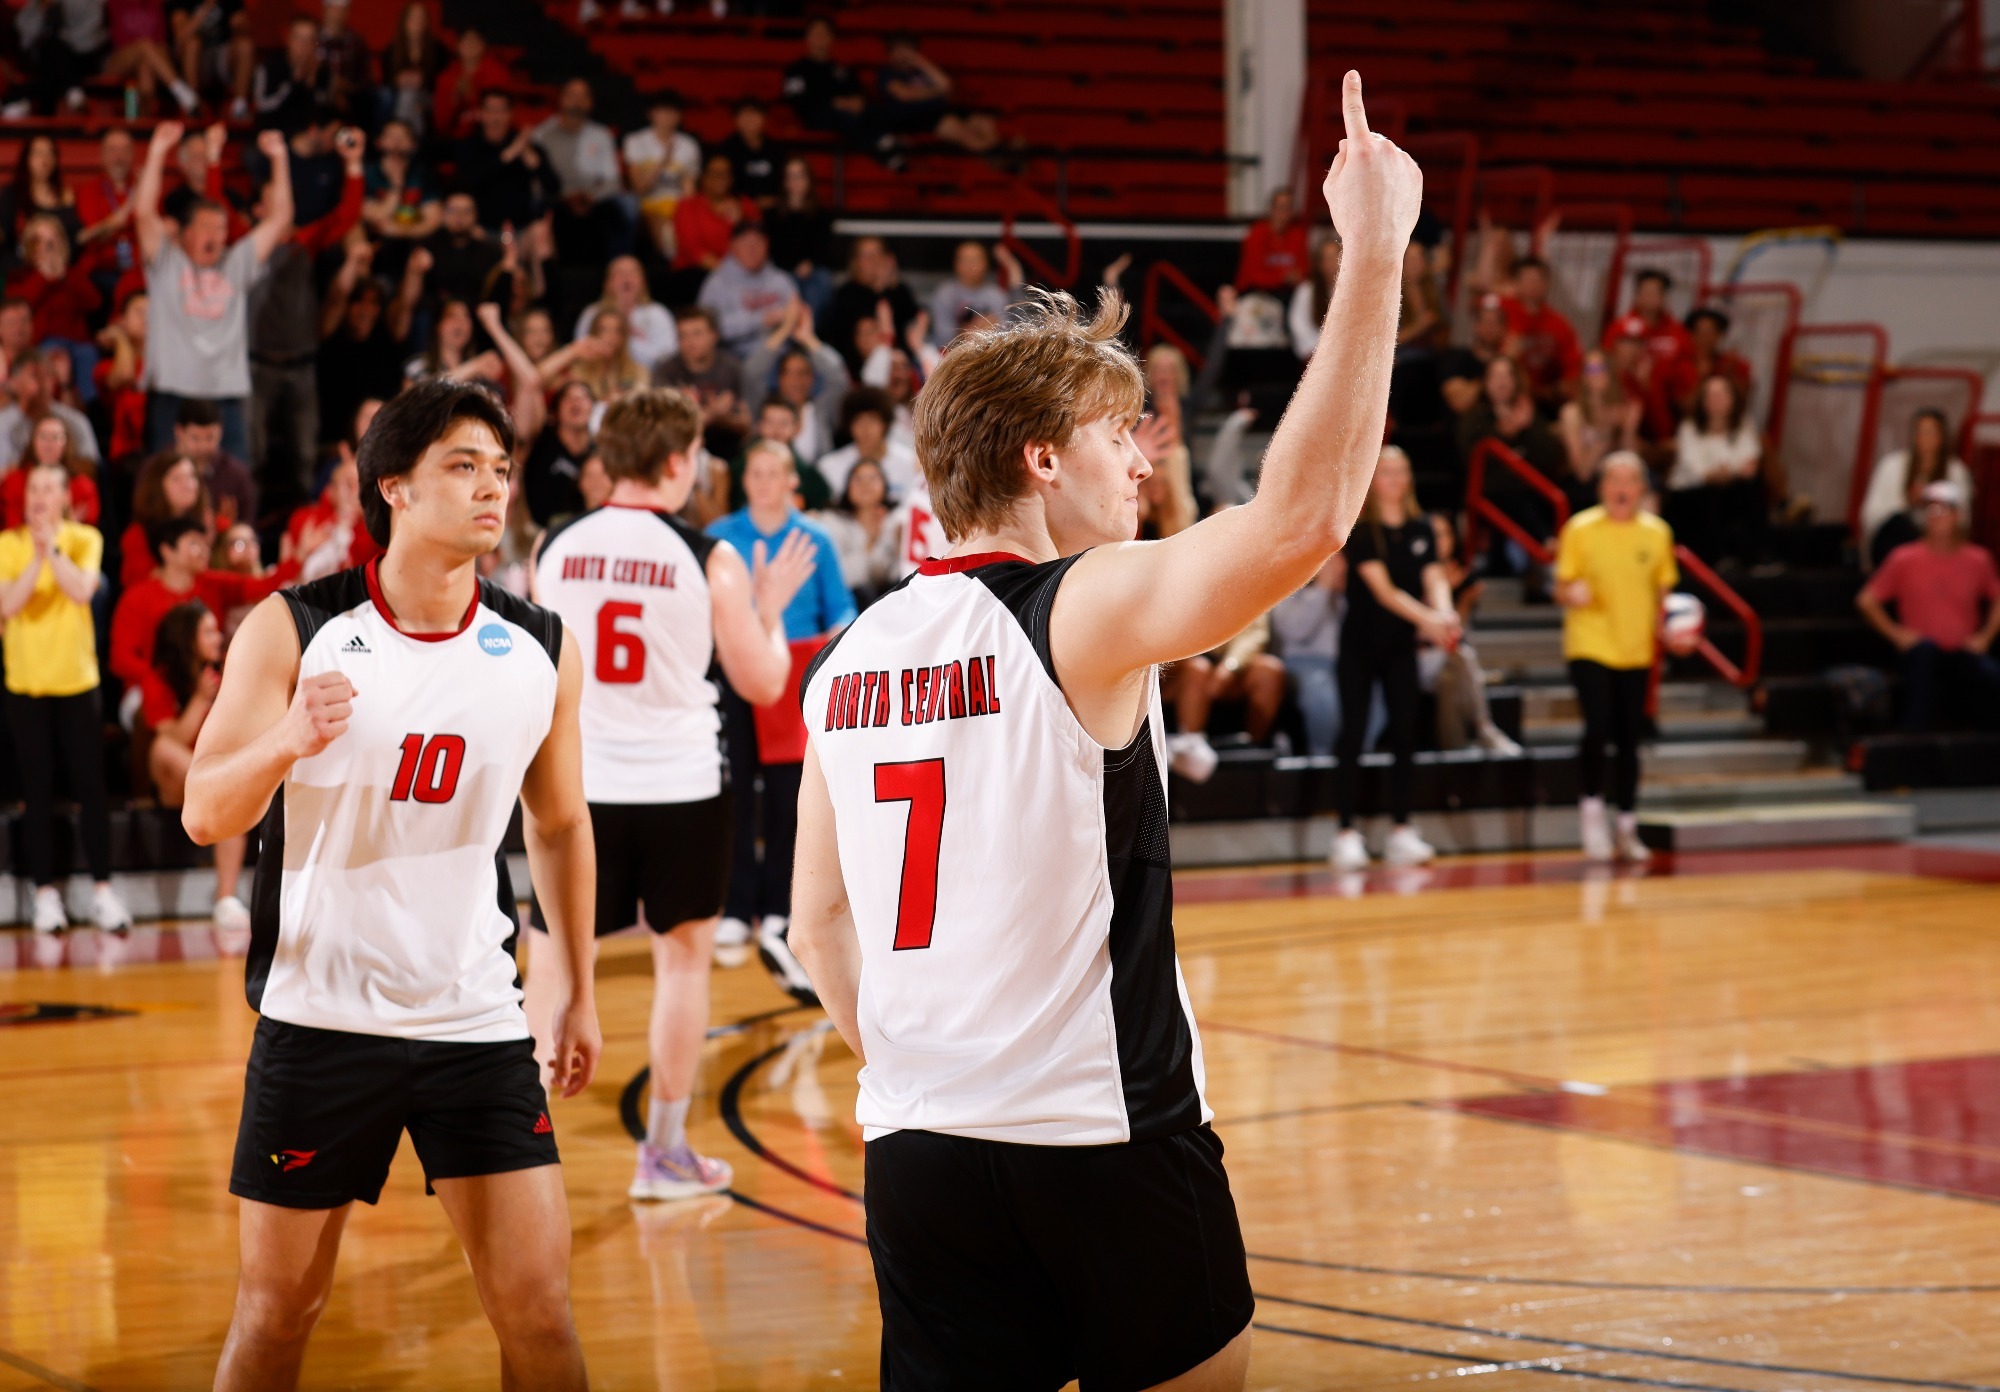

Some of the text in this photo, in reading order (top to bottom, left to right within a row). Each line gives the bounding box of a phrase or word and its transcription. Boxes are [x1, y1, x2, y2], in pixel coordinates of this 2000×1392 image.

[562, 556, 676, 589] NORTH CENTRAL
[483, 637, 512, 649] NCAA
[595, 599, 646, 684] 6
[825, 655, 1000, 732] NORTH CENTRAL
[389, 733, 466, 804] 10
[874, 757, 946, 951] 7
